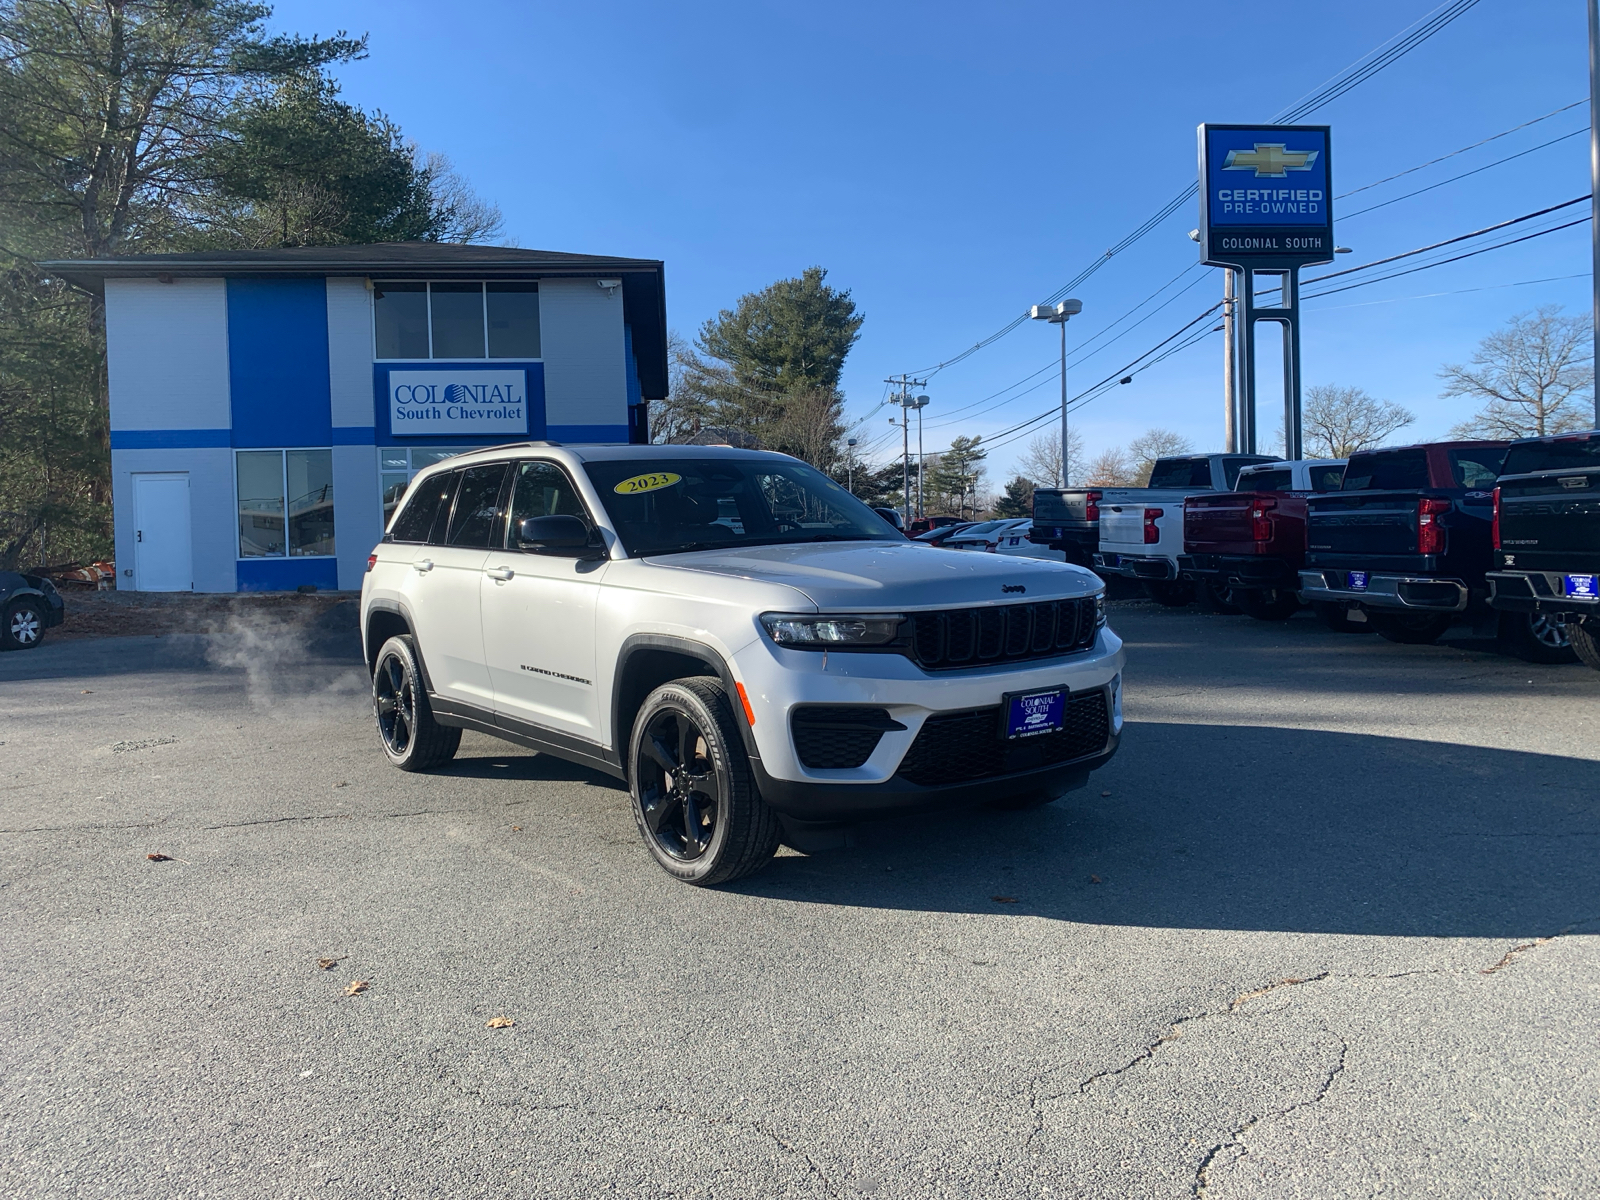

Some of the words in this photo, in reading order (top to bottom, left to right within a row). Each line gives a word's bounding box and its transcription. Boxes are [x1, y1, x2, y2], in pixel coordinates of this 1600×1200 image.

[1218, 189, 1323, 201] CERTIFIED
[1224, 202, 1318, 214] PRE-OWNED
[1222, 237, 1279, 249] COLONIAL
[1285, 237, 1322, 248] SOUTH
[394, 383, 522, 404] COLONIAL
[396, 406, 441, 420] South
[446, 405, 522, 420] Chevrolet
[627, 474, 669, 492] 2023
[1020, 696, 1055, 708] COLONIAL
[1024, 704, 1049, 715] SOUTH
